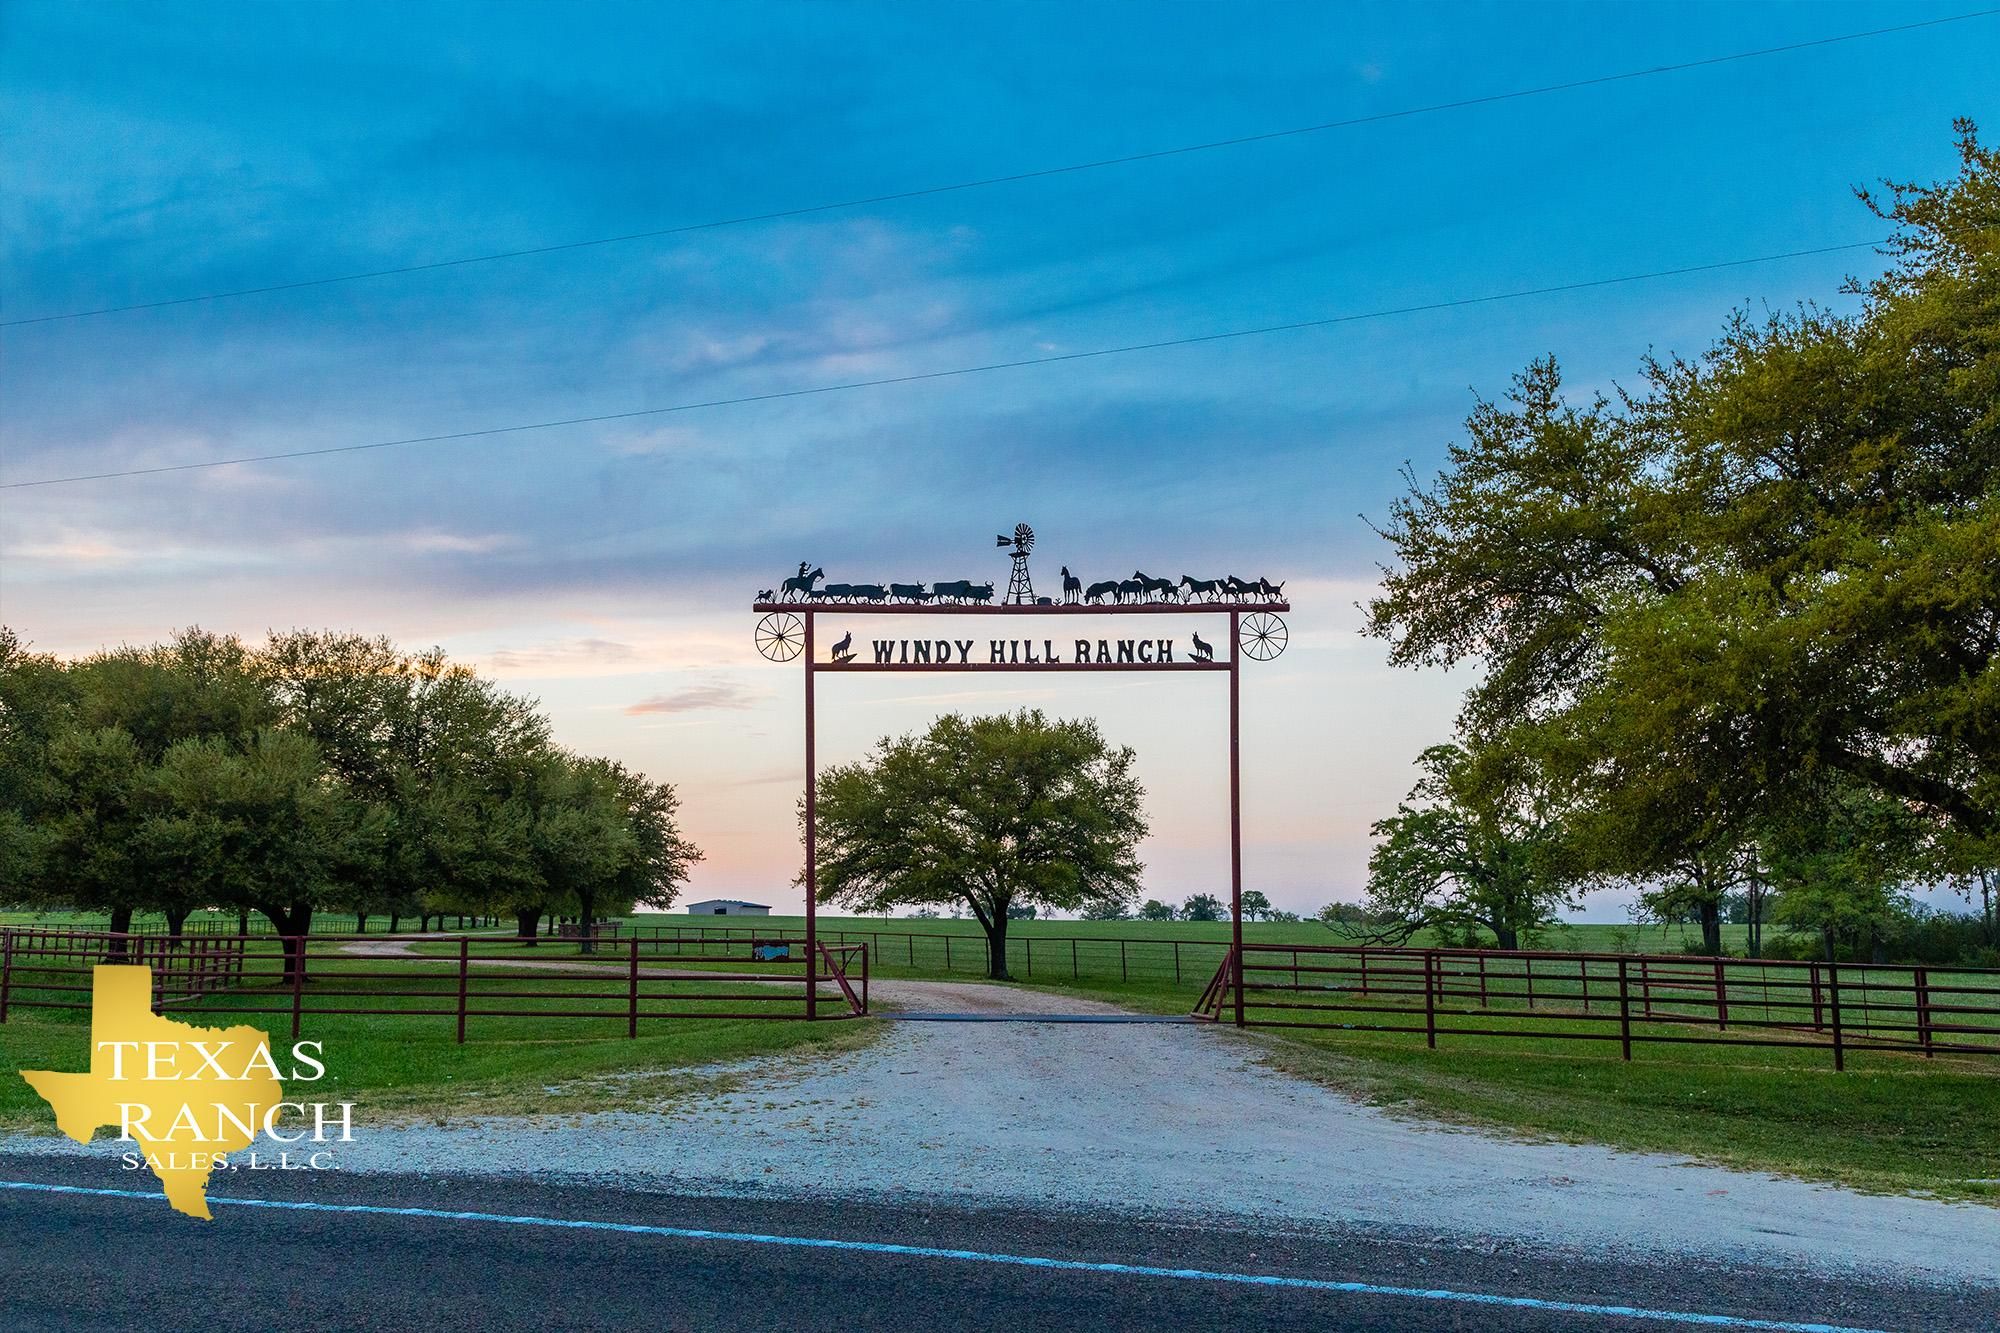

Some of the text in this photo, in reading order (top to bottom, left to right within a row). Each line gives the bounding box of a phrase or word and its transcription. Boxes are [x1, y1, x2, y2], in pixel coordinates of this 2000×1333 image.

[872, 639, 1174, 664] WINDY HILL RANCH
